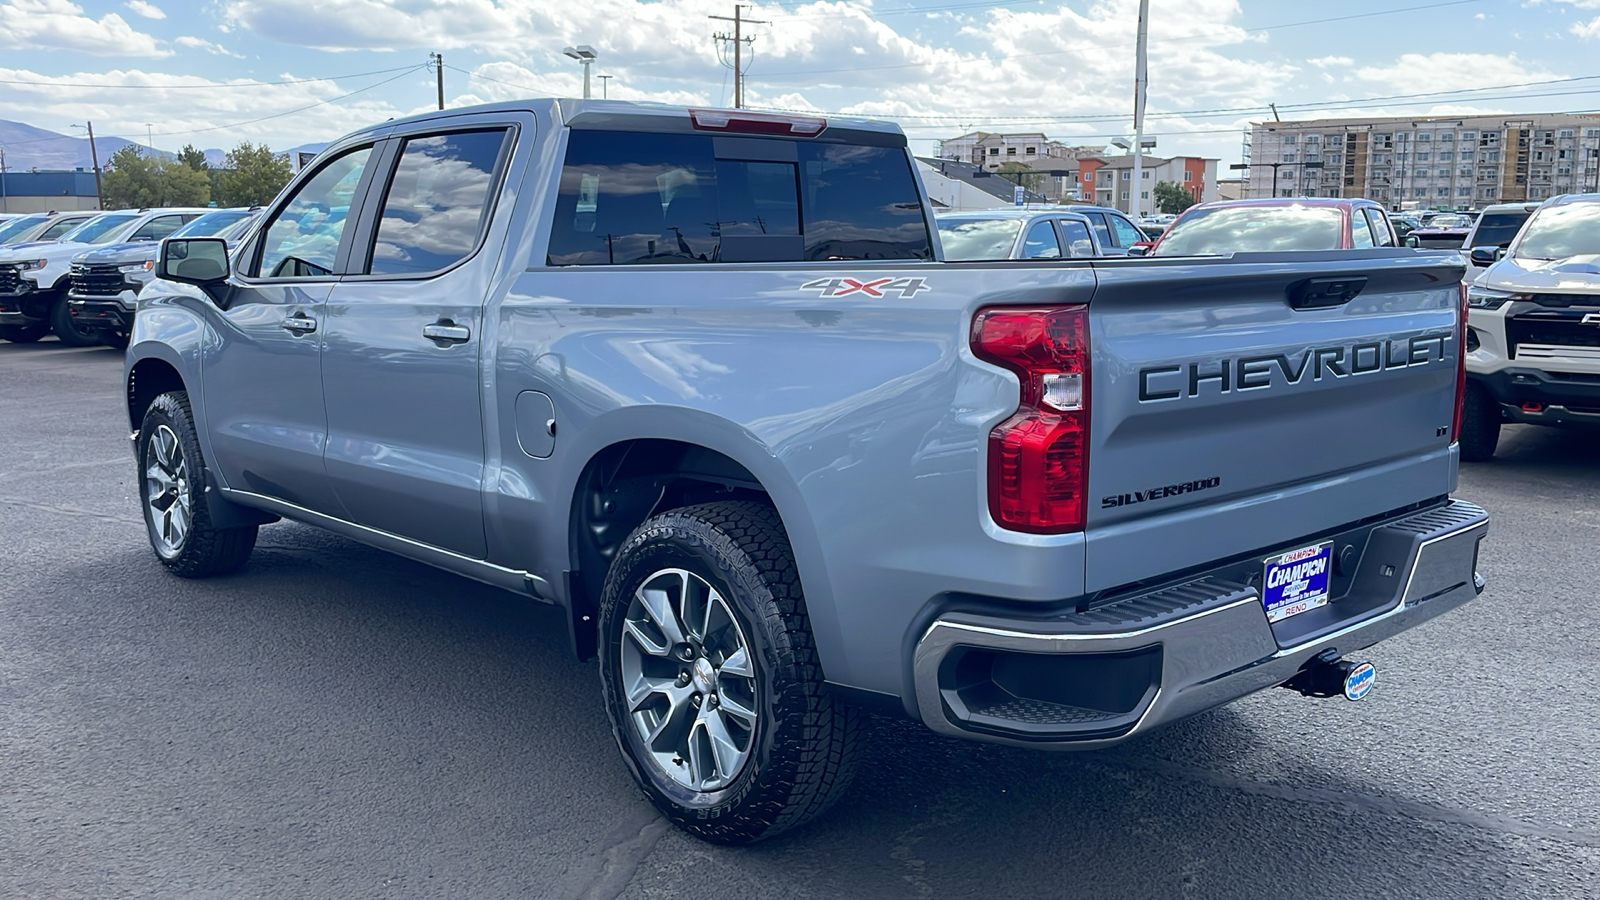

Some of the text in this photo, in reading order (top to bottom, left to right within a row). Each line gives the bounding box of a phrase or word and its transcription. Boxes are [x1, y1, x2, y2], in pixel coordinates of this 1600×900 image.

[1139, 333, 1453, 403] CHEVROLET
[1101, 476, 1221, 509] SILVERADO
[1283, 547, 1316, 564] CHAMPION
[1267, 557, 1327, 589] CHAMPION
[1285, 602, 1307, 616] RENO
